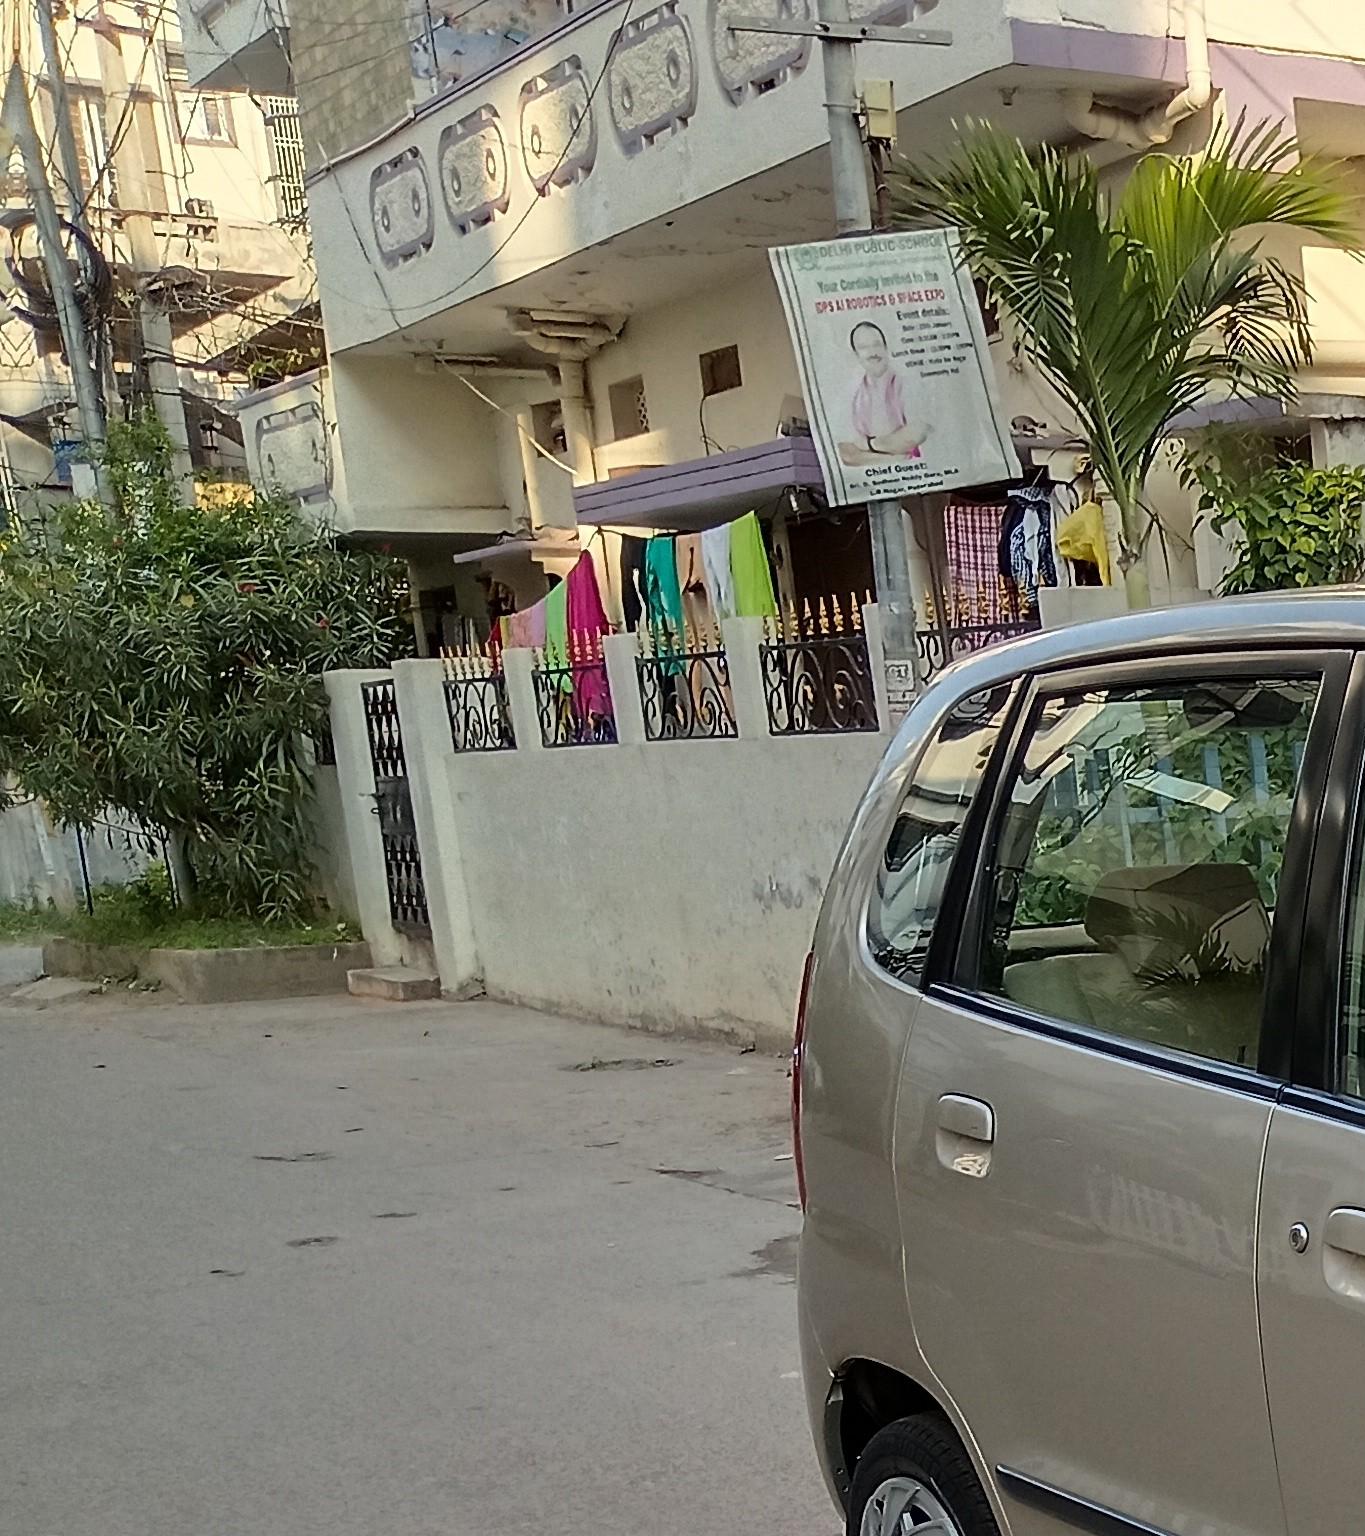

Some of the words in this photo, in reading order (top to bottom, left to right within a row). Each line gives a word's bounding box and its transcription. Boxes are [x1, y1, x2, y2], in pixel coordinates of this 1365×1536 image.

[819, 243, 853, 258] DELHI
[854, 239, 895, 255] PUBLIC
[899, 235, 943, 249] SCHOOL
[846, 294, 887, 310] ROBOTICS
[897, 290, 923, 304] SPACE
[924, 288, 945, 301] EXPO
[865, 465, 891, 477] Chief
